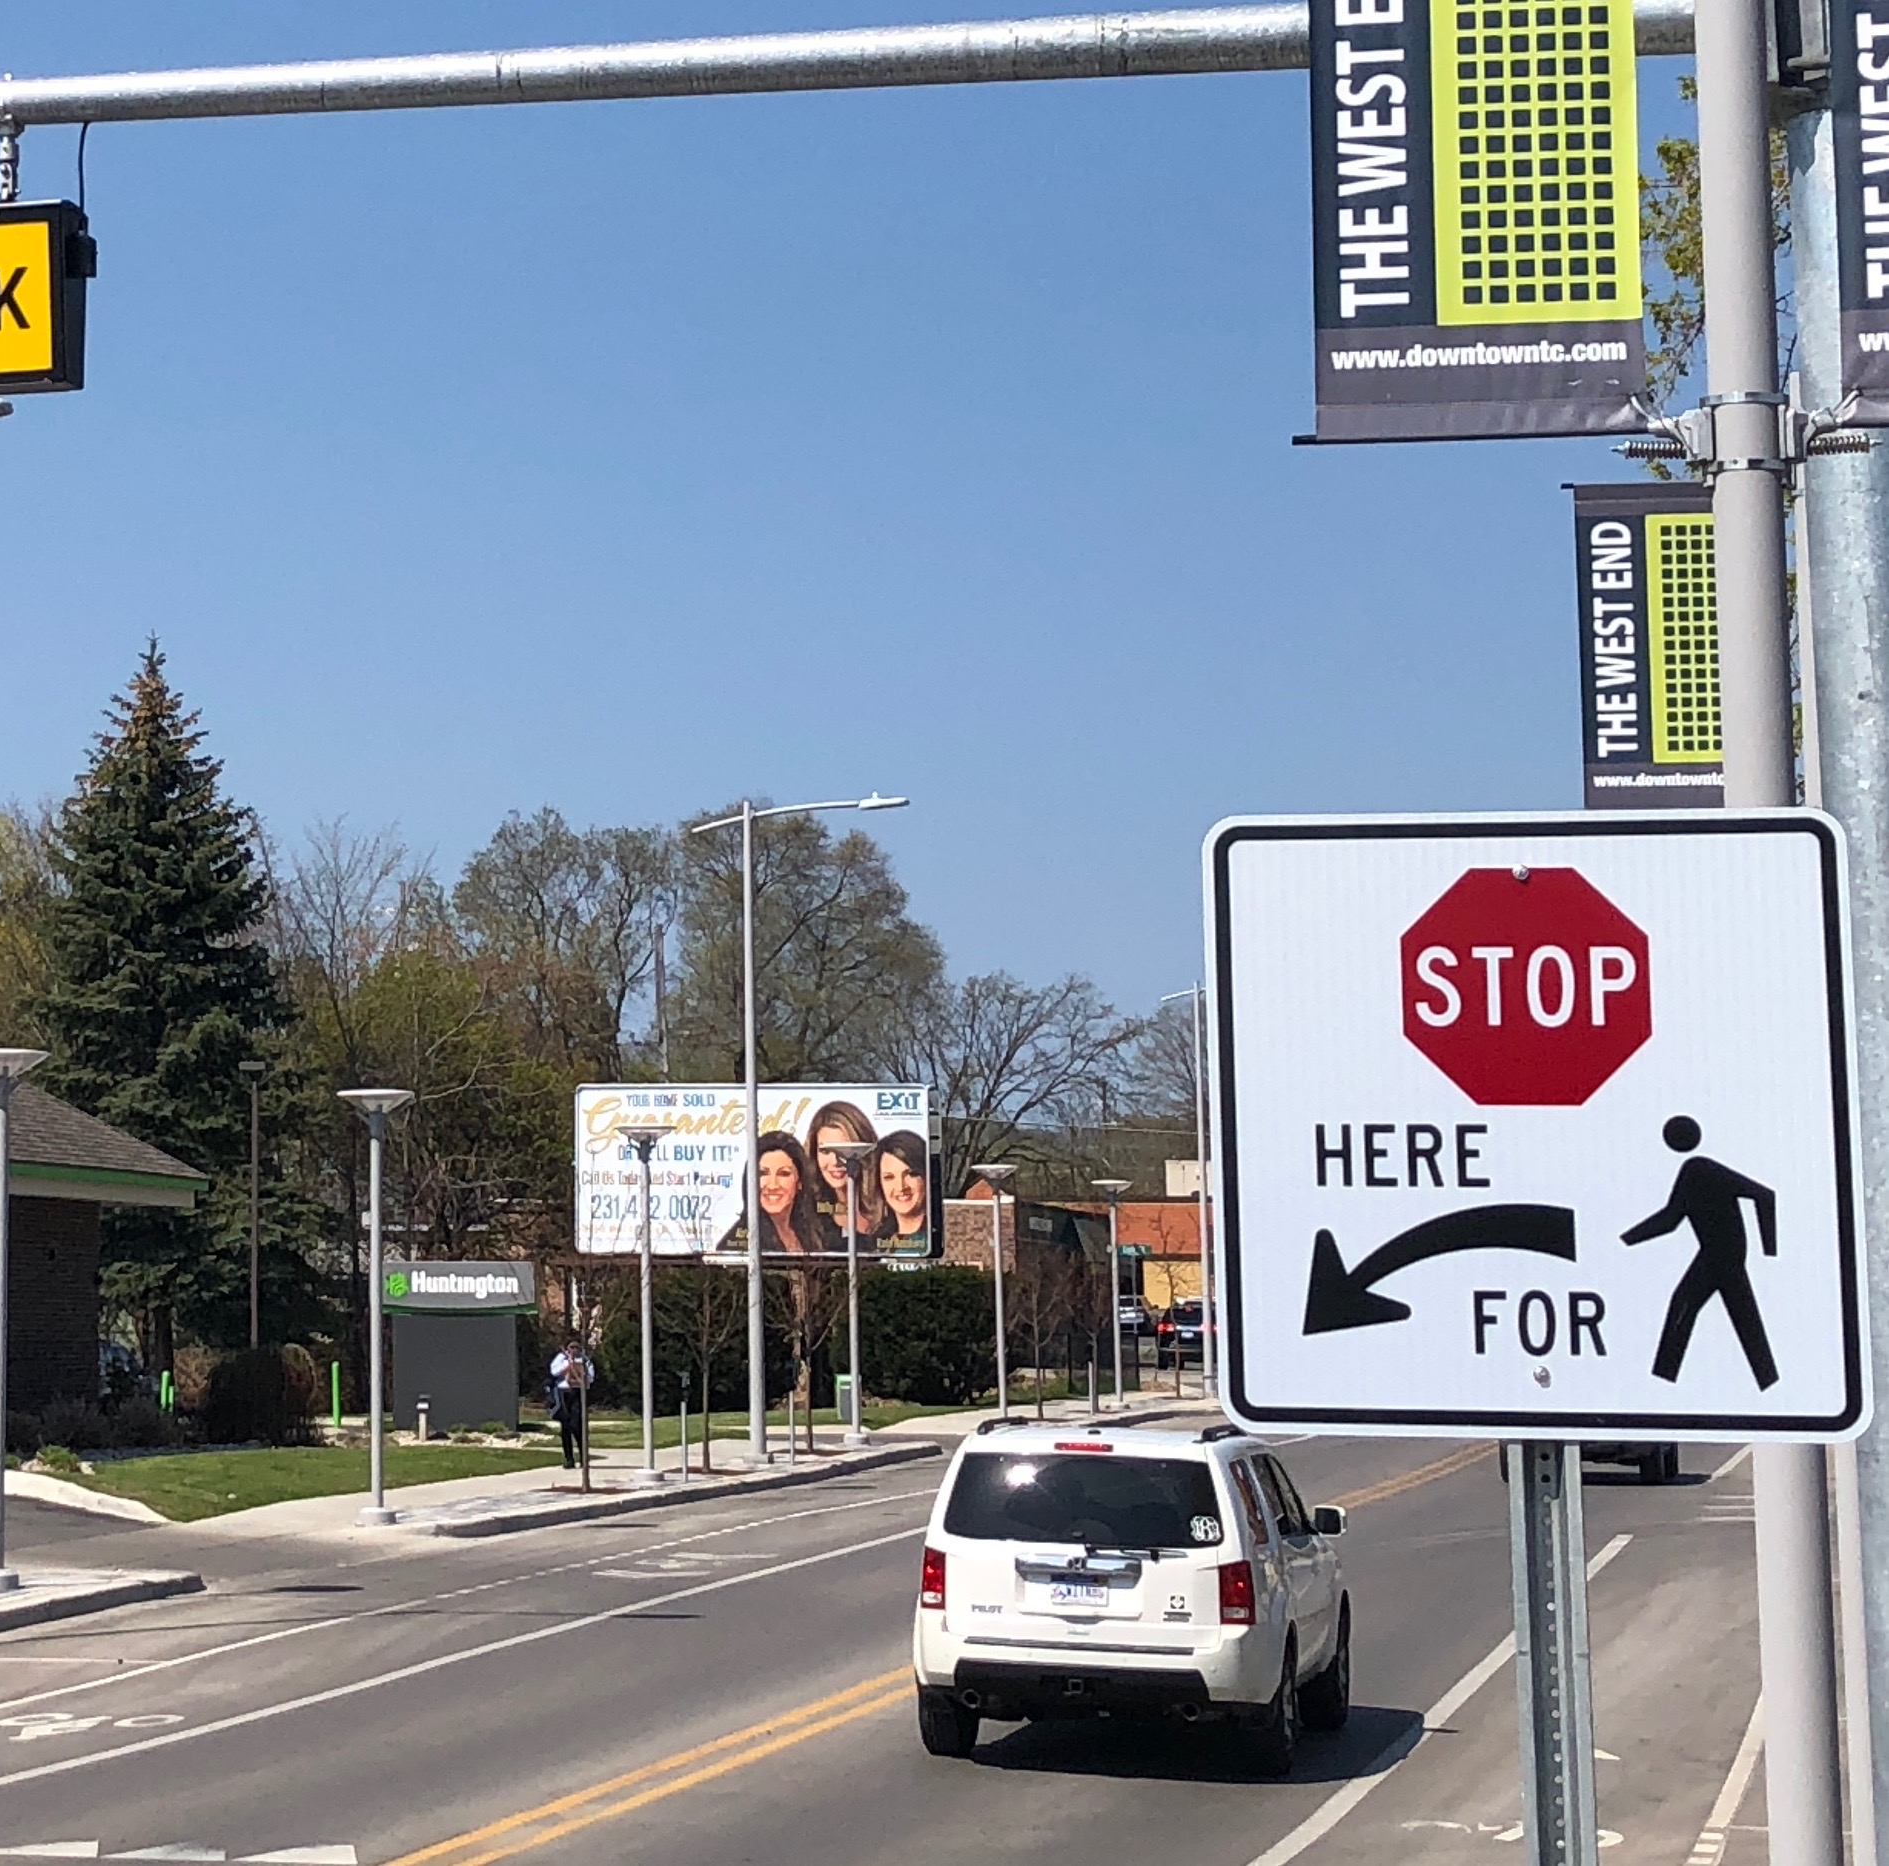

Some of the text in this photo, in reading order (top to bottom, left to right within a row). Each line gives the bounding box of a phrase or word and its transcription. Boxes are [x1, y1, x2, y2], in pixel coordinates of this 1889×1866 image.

[1335, 41, 1408, 196] WEST
[1338, 205, 1410, 318] THE
[1331, 341, 1628, 370] www.downtowntc.com
[1590, 521, 1639, 757] THE WEST END
[1415, 945, 1637, 1028] STOP
[582, 1096, 811, 1154] Guaranted!
[683, 1094, 715, 1107] SOLD
[674, 1145, 705, 1161] BUY
[1316, 1124, 1491, 1188] HERE
[411, 1270, 519, 1299] Huntington
[1472, 1289, 1608, 1357] FOR
